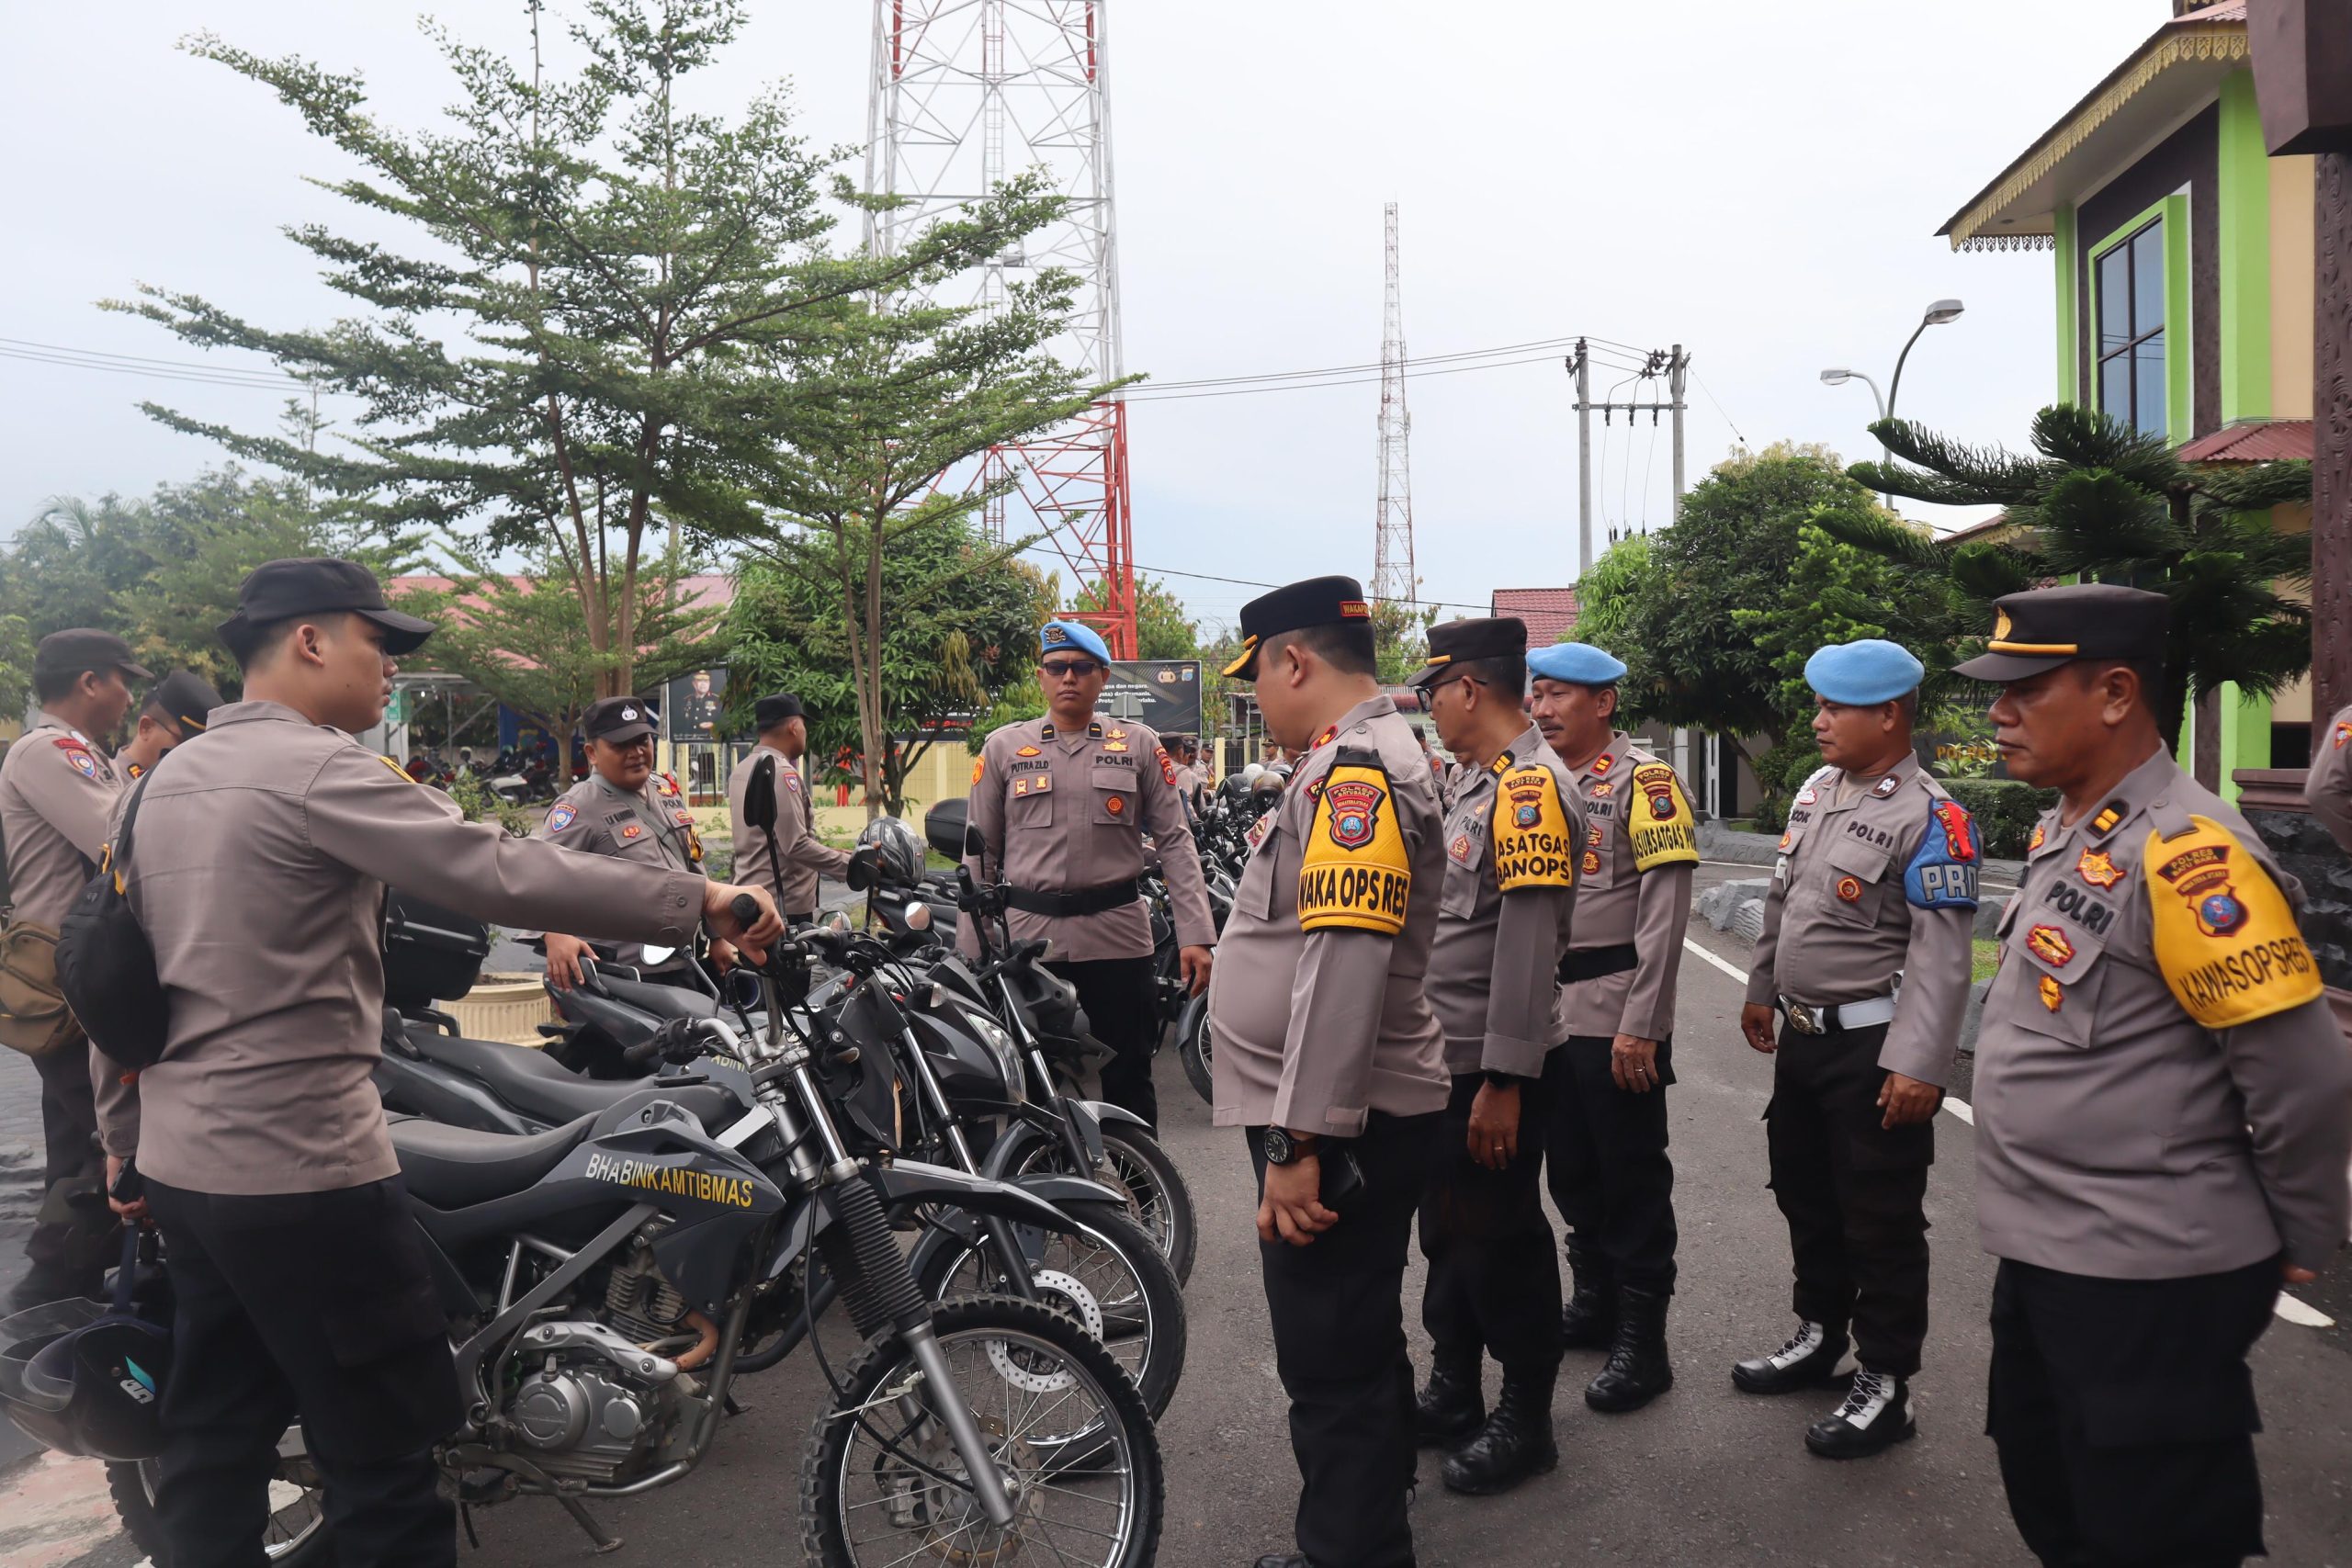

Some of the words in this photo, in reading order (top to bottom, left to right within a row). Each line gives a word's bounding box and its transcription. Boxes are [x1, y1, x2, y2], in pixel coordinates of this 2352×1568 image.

[1343, 604, 1368, 615] WAKAPO
[1096, 755, 1133, 766] POLRI
[1498, 833, 1569, 860] ASATGAS
[1632, 824, 1684, 860] ASUBSATGAS
[1847, 820, 1894, 849] POLRI
[2171, 848, 2214, 869] POLRES
[1299, 868, 1336, 913] WAKA
[1340, 867, 1380, 911] OPS
[1383, 873, 1408, 919] RES
[2044, 880, 2115, 935] POLRI
[585, 1153, 753, 1208] BHABINKAMTIBMAS
